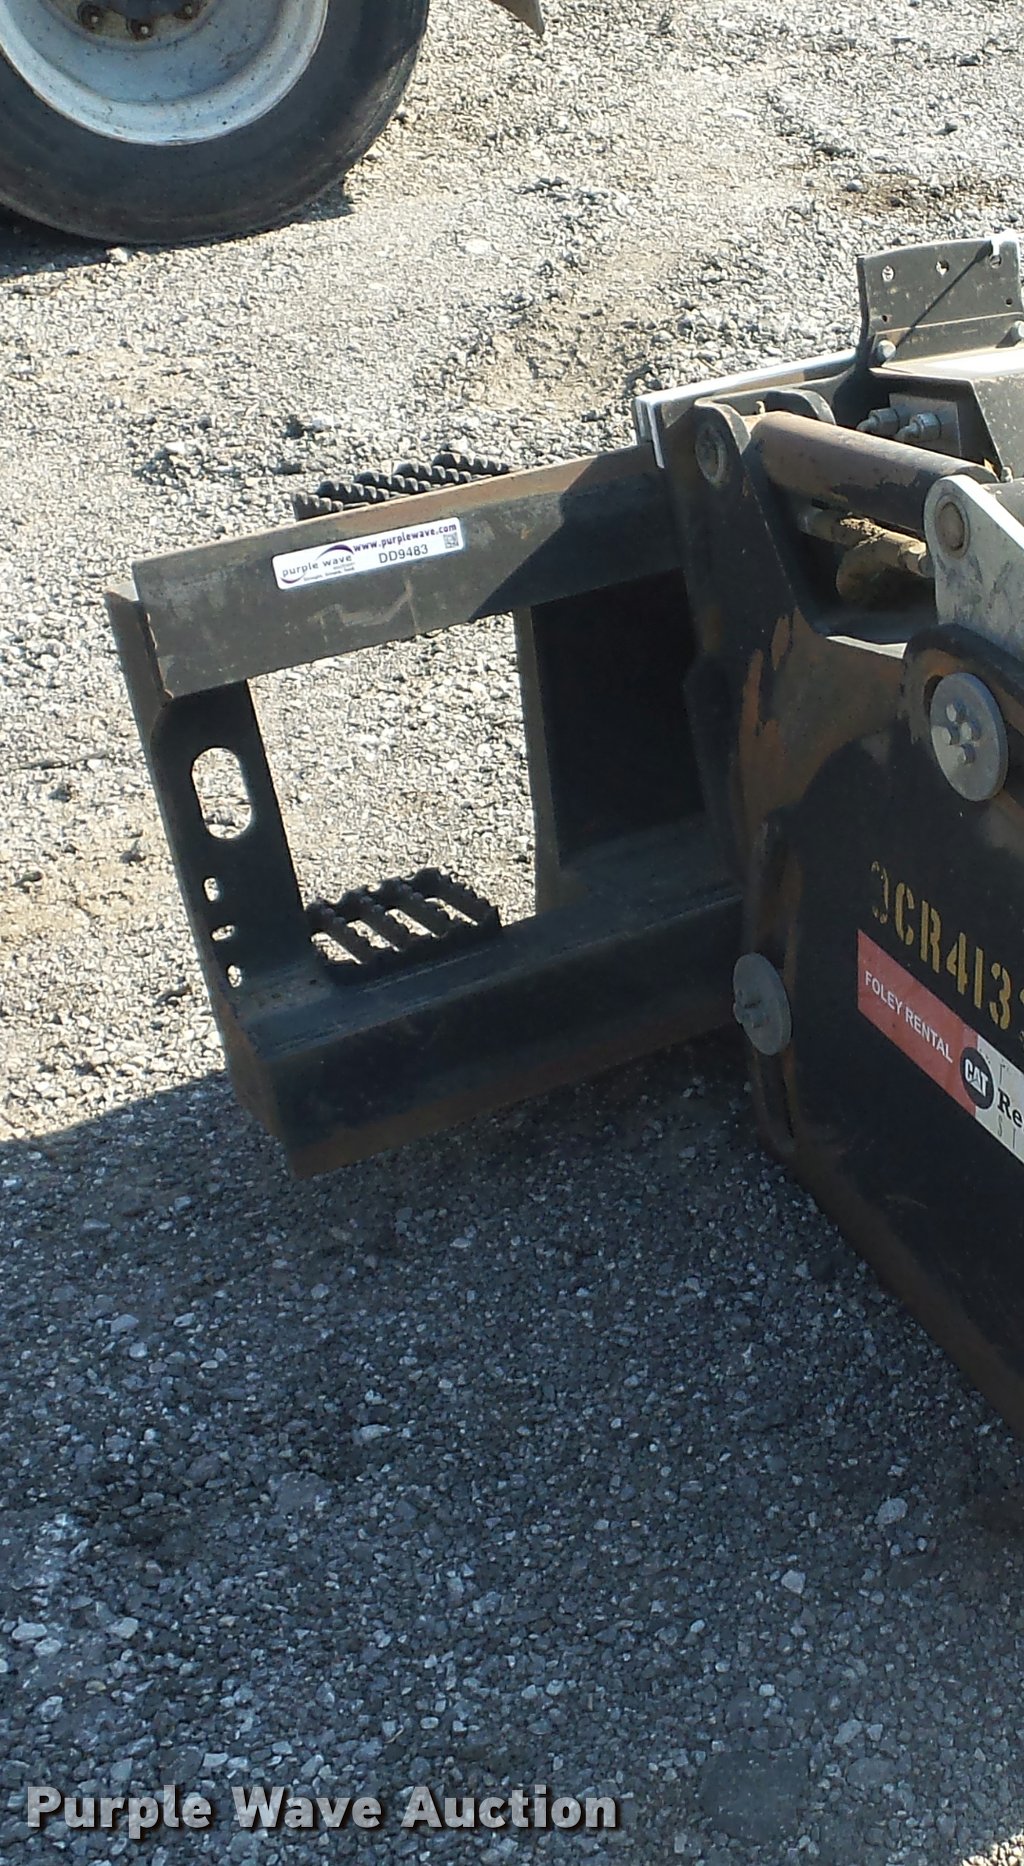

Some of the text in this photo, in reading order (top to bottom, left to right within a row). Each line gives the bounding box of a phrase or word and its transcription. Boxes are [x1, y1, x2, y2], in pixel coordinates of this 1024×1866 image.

[353, 524, 457, 552] www.purplewave.com
[282, 562, 319, 577] purple
[322, 555, 352, 567] wave
[378, 544, 429, 564] DD9483
[864, 970, 954, 1064] FOLEY RENTAL
[964, 1058, 989, 1098] CAT
